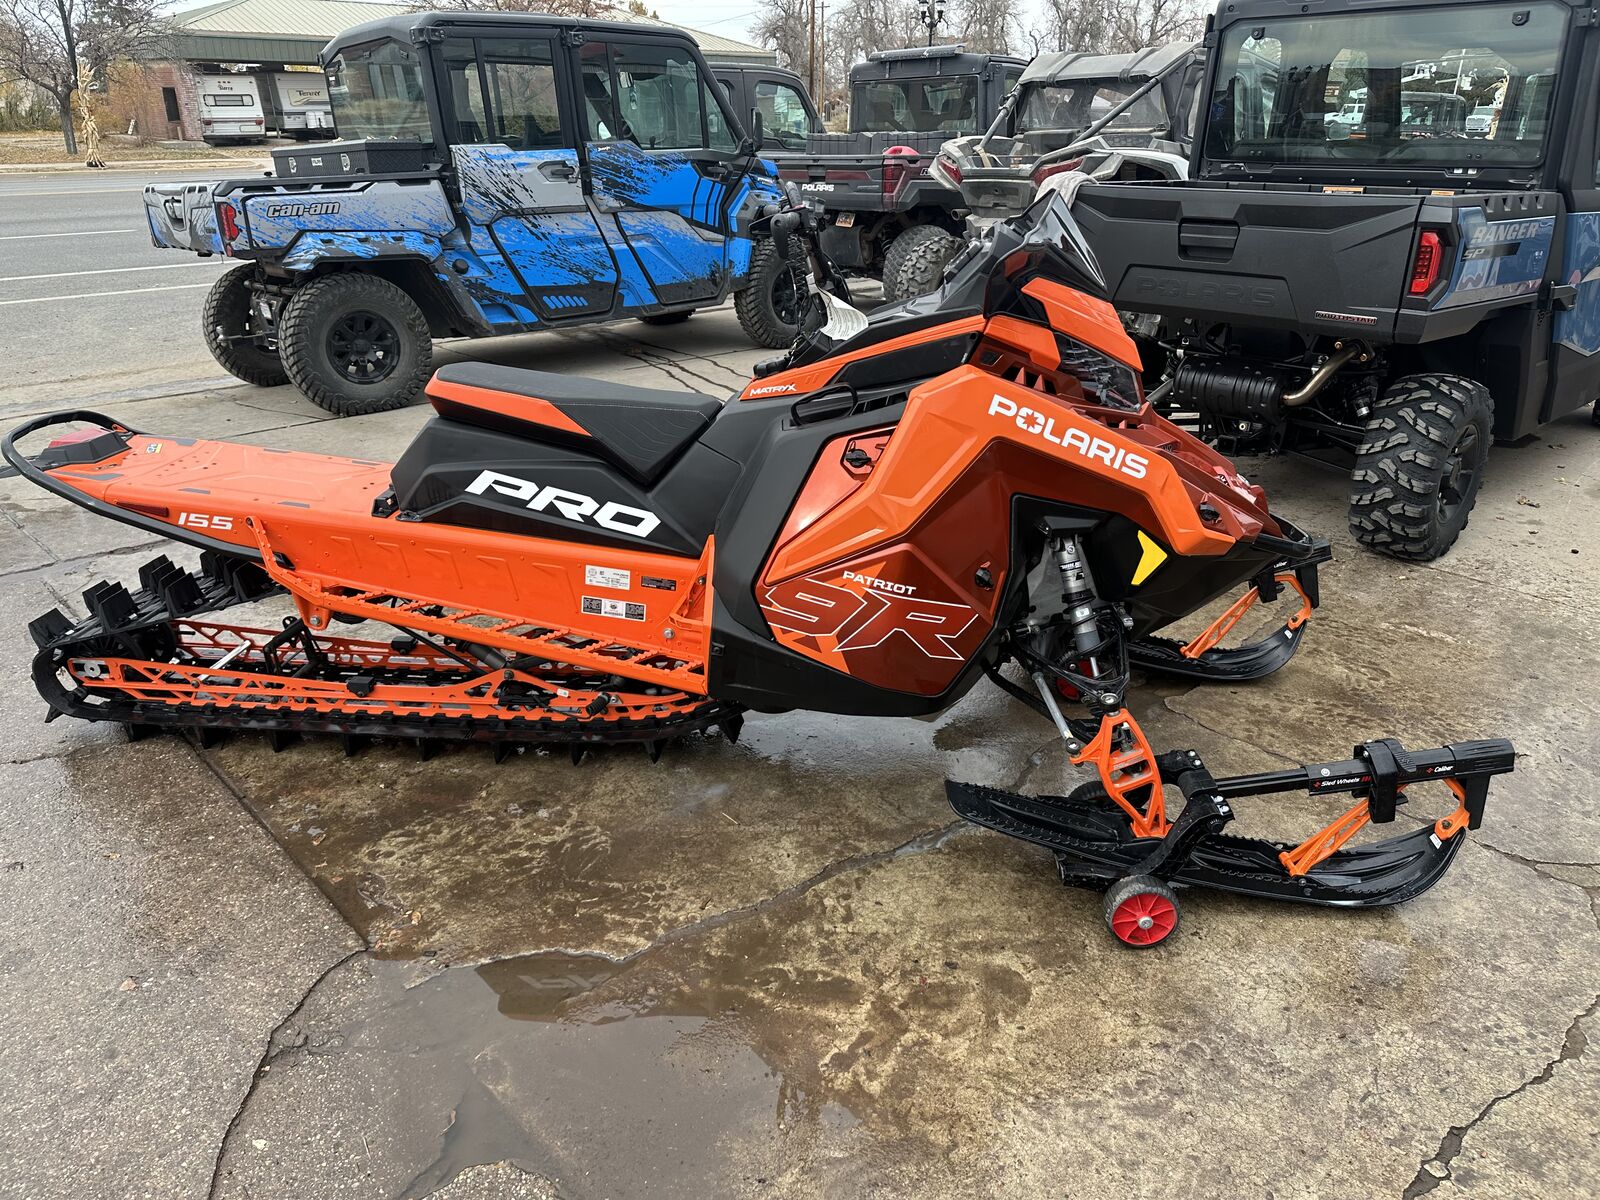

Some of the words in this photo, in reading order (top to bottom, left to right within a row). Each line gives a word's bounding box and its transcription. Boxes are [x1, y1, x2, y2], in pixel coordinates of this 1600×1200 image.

[801, 183, 835, 192] POLARIS
[267, 202, 341, 218] can-am
[1471, 222, 1539, 244] RANGER
[1462, 248, 1485, 260] SP
[1136, 275, 1277, 307] POLARIS
[750, 384, 797, 397] MATRYX
[988, 394, 1149, 479] POLARIS
[464, 469, 661, 538] PRO
[178, 512, 233, 530] 155
[842, 570, 917, 595] PATRIOT
[1337, 777, 1360, 785] Wheels
